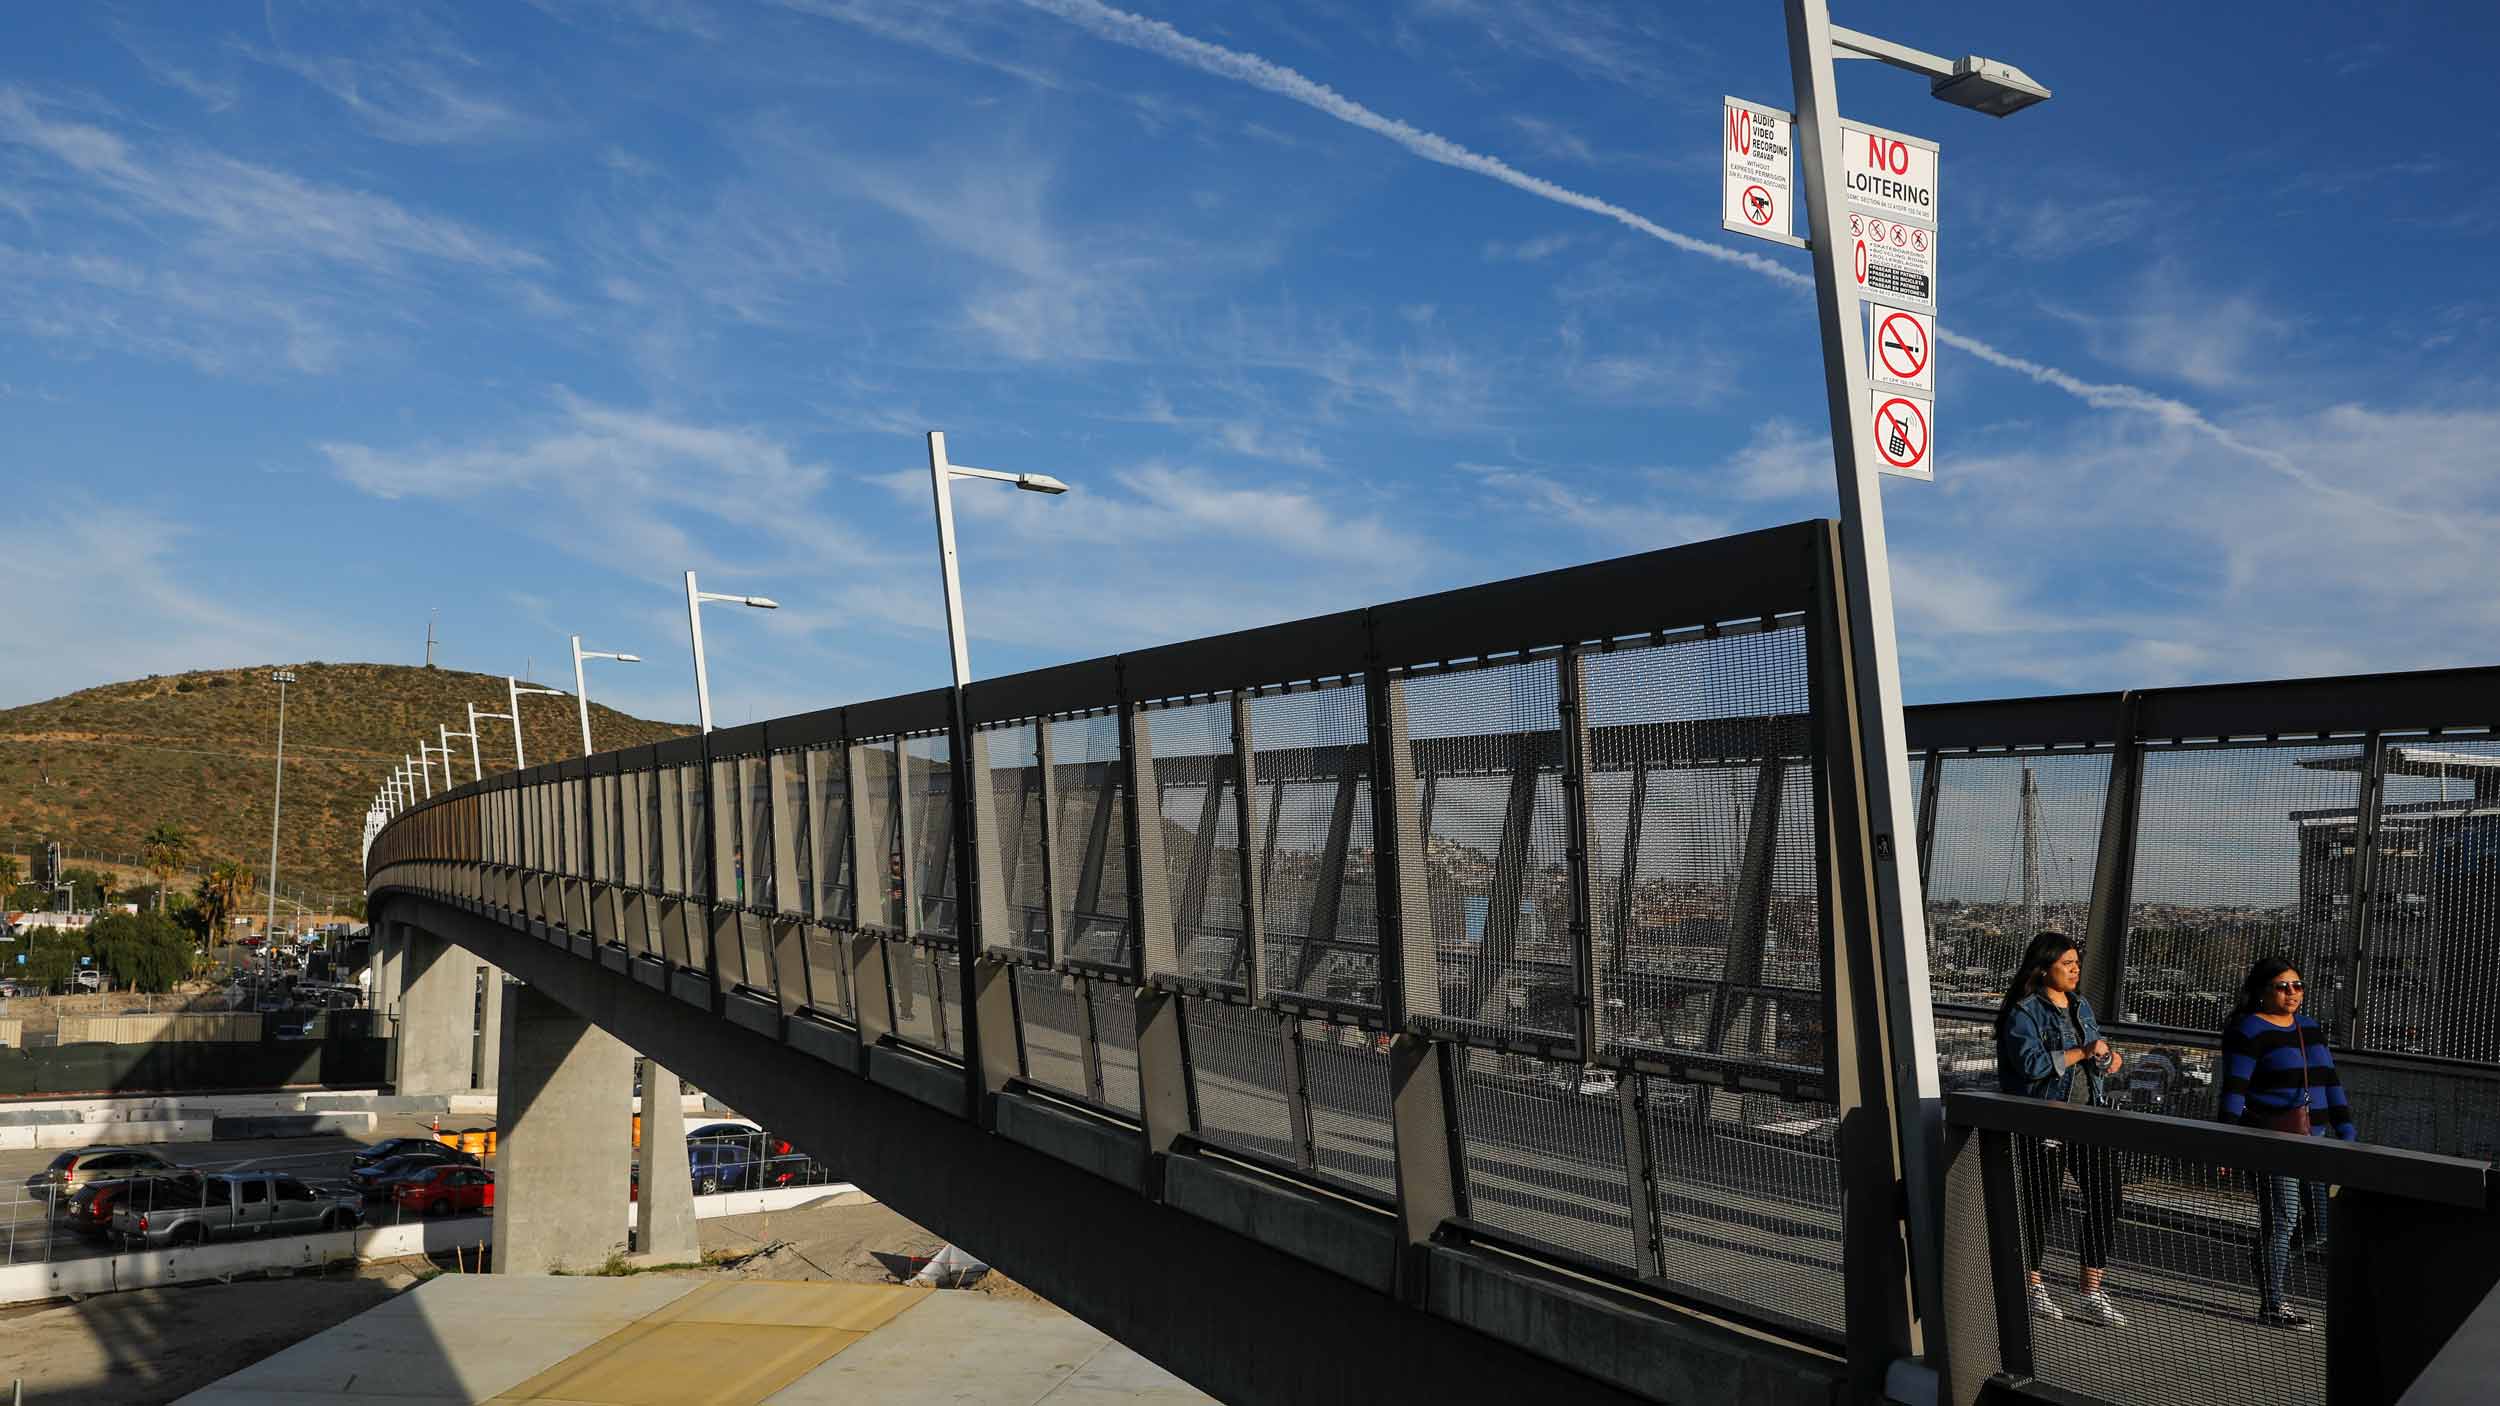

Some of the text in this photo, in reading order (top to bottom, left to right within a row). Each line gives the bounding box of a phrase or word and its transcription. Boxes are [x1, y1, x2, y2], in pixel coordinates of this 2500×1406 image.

[1752, 113, 1775, 128] AUDIO
[1729, 107, 1751, 155] NO
[1752, 126, 1774, 140] VIDEO
[1752, 138, 1788, 157] RECORDING
[1752, 150, 1774, 161] GRAVAR
[1869, 134, 1909, 175] NO
[1746, 160, 1770, 171] WITHOUT
[1847, 170, 1929, 206] LOITERING
